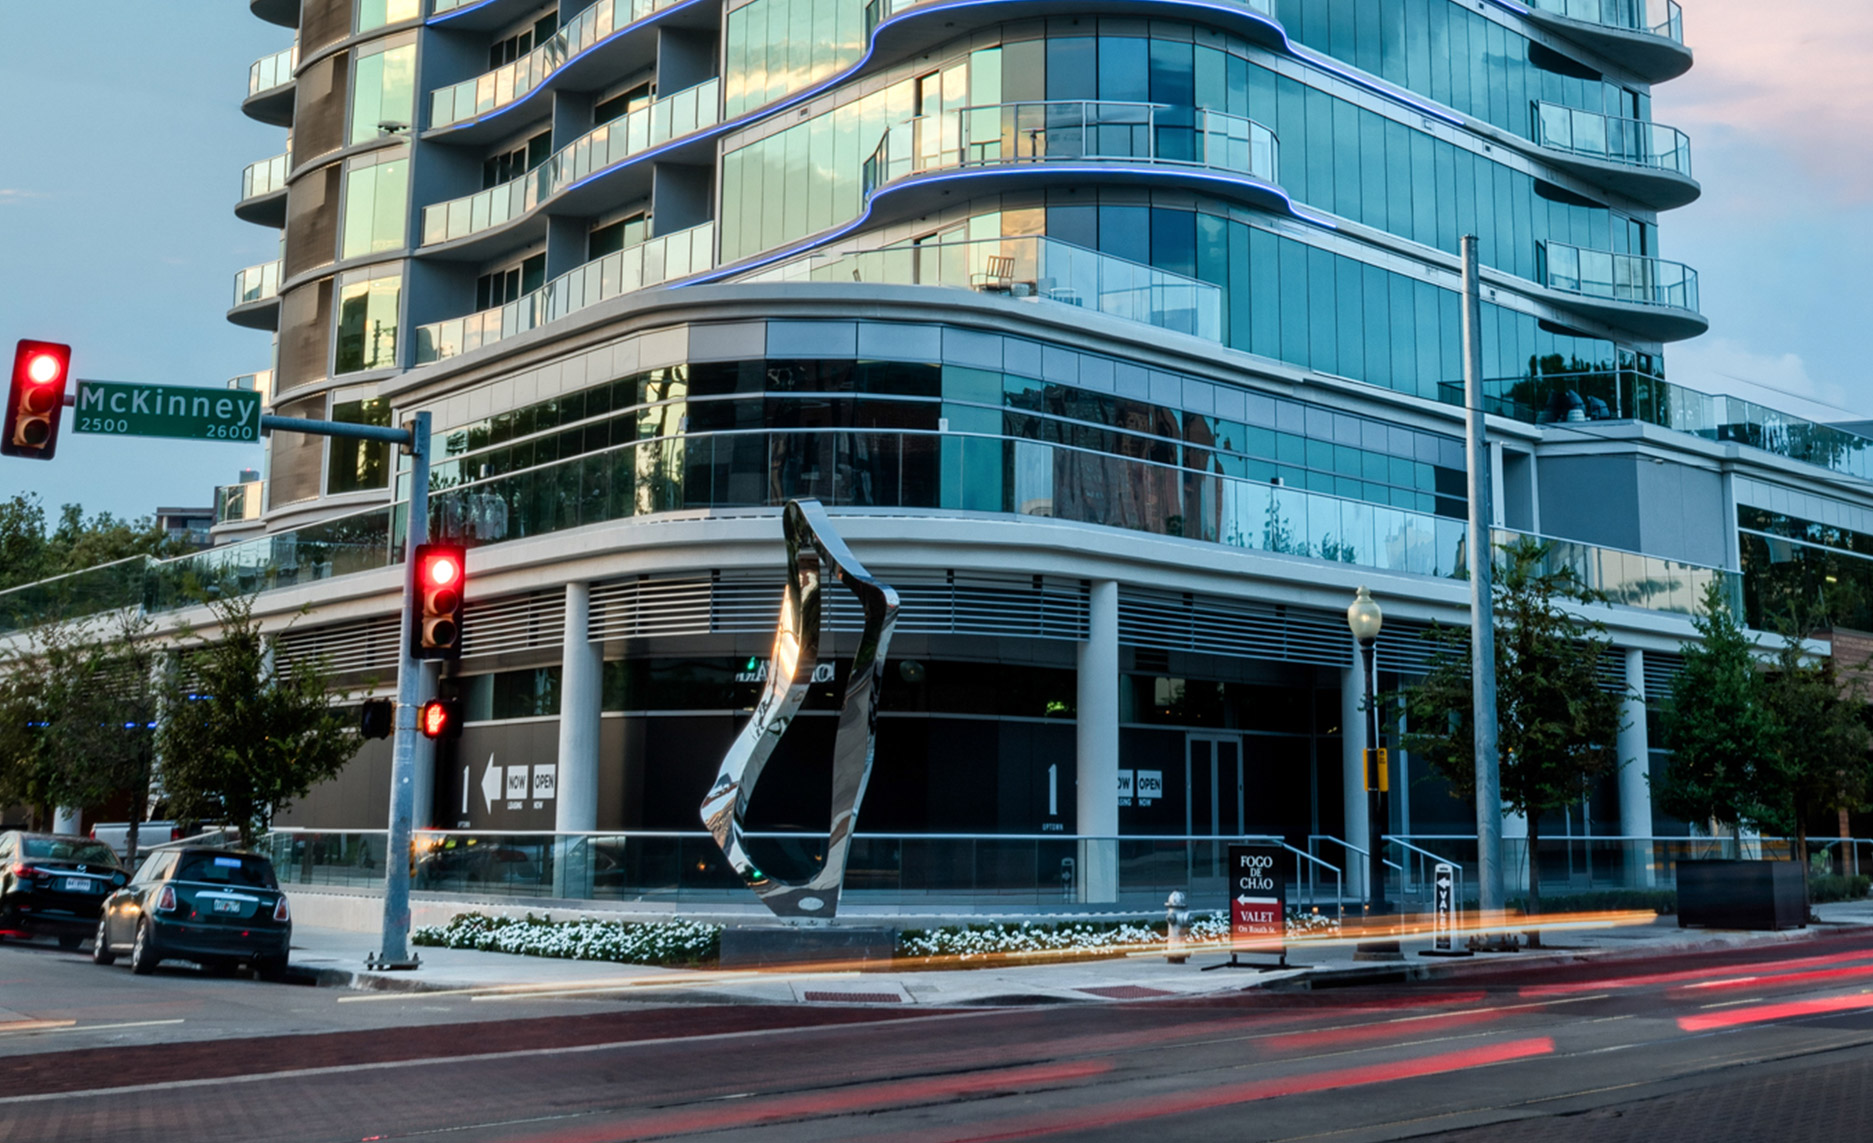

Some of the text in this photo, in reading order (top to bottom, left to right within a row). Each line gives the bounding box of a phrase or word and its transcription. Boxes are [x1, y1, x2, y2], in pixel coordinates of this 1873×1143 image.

[81, 386, 255, 427] McKinney
[81, 418, 253, 440] 2500 2600
[508, 774, 554, 790] NOW OPEN
[1118, 777, 1160, 791] OW OPEN
[1240, 855, 1273, 868] FOGO
[1250, 868, 1262, 877] DE
[1240, 911, 1274, 923] VALET
[1439, 890, 1447, 937] VALET
